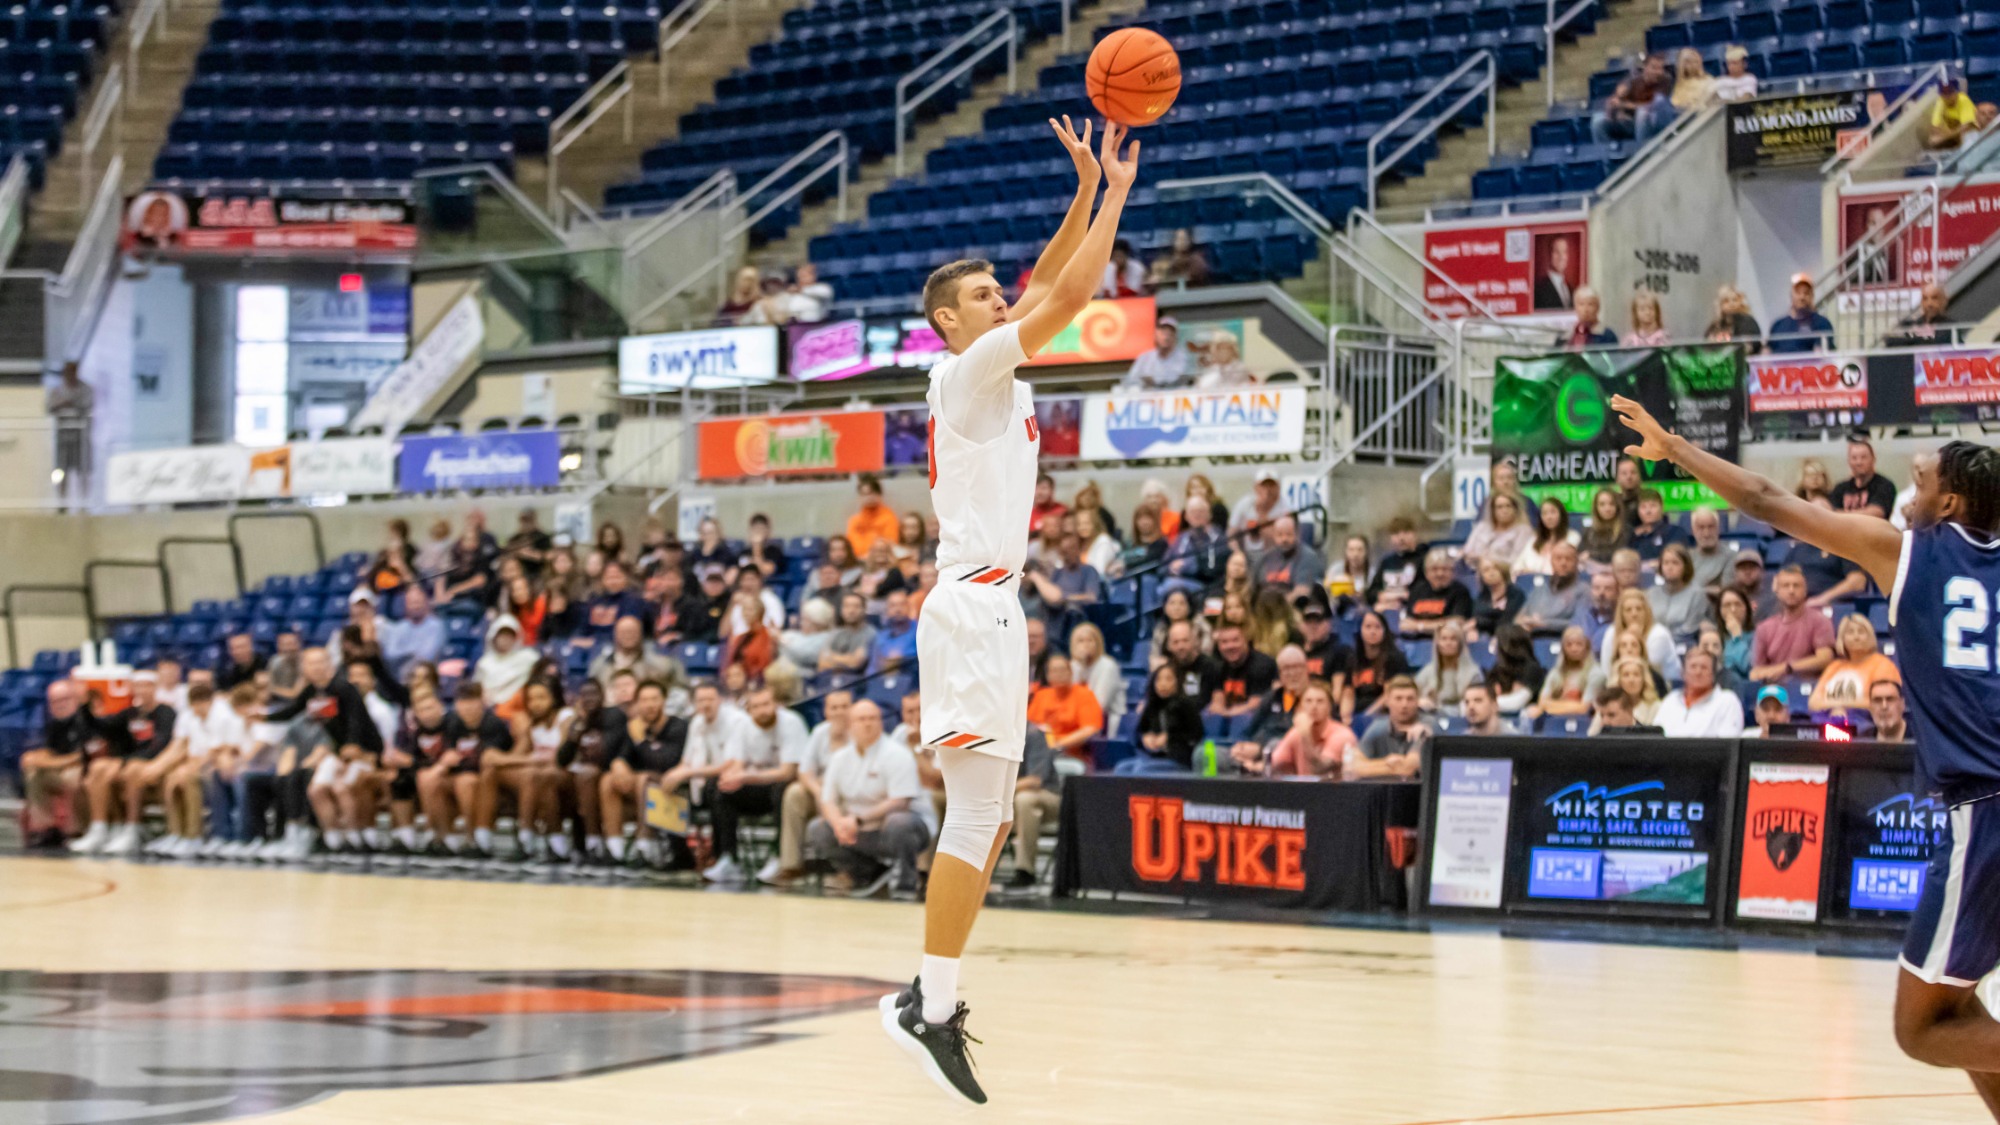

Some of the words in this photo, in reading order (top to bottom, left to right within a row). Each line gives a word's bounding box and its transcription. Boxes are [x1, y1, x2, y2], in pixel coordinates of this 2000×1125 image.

[1734, 107, 1808, 135] RAYMOND
[1808, 105, 1858, 127] JAMES
[1107, 392, 1281, 429] MOUNTAIN
[1552, 799, 1705, 821] MIKROTEC
[1557, 817, 1602, 833] SIMPLE.
[1605, 819, 1639, 834] SAFE.
[1641, 819, 1691, 836] SECURE.
[1753, 807, 1818, 844] UPIKE
[1881, 829, 1929, 845] SIMPLE.
[1129, 796, 1306, 890] UPIKE
